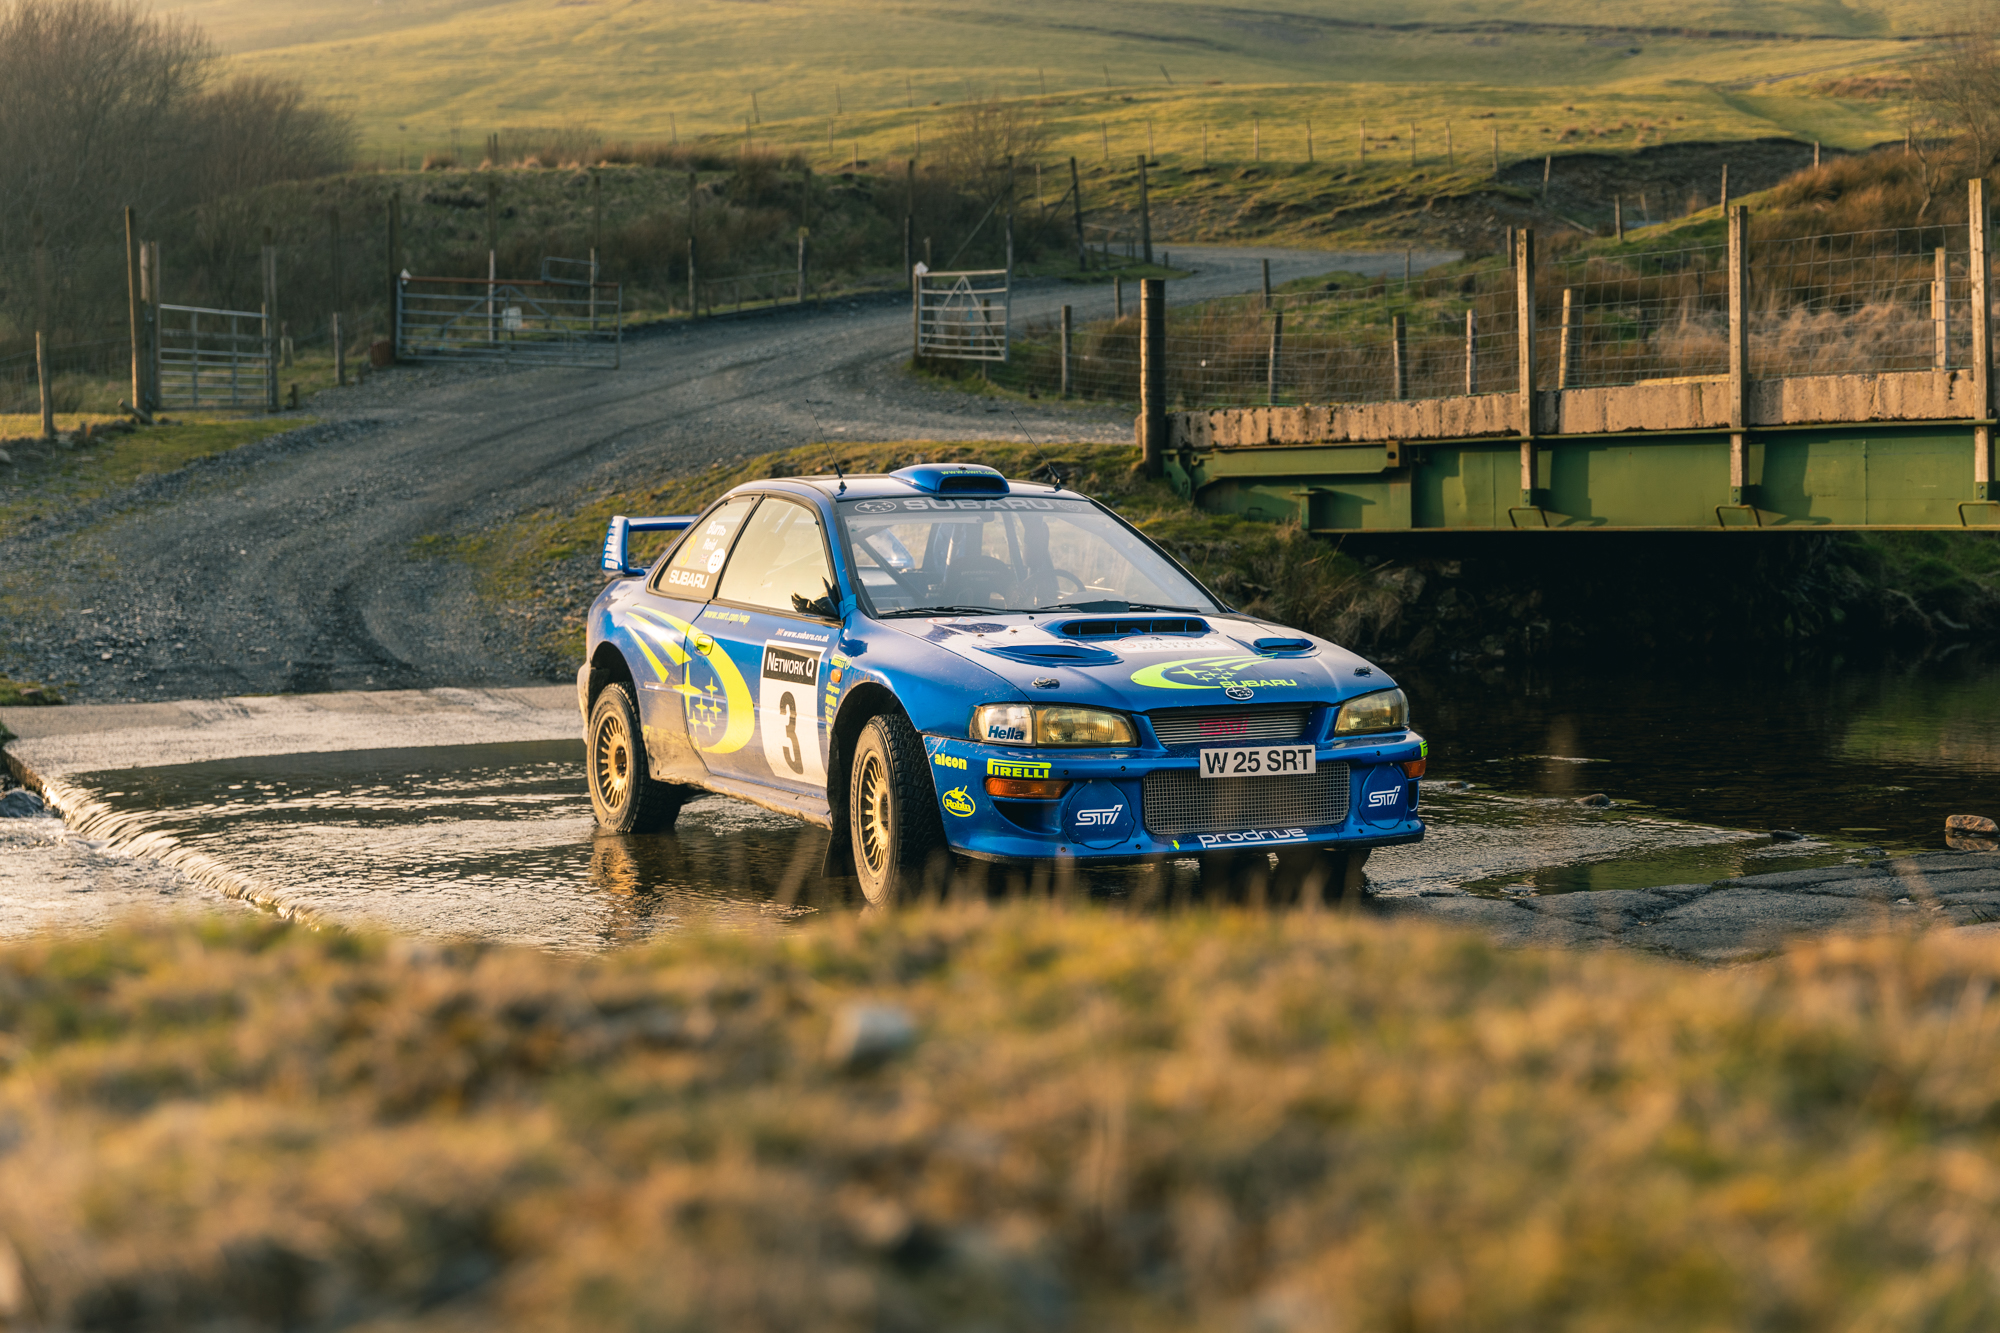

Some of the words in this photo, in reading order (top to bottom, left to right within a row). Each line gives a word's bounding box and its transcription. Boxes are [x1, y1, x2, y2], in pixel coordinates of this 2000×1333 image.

[903, 499, 1054, 511] SUBARU
[680, 534, 697, 566] 3
[668, 569, 710, 588] SUBARU
[782, 630, 830, 643] www.subaru.co.uk
[805, 657, 815, 678] Q
[1219, 679, 1297, 688] SUBARU
[780, 691, 804, 775] 3
[987, 725, 1025, 741] Hella
[934, 753, 967, 770] alcon
[987, 758, 1052, 779] PIRELLI
[1204, 751, 1229, 774] W
[1233, 750, 1261, 773] 25
[1266, 748, 1312, 773] SRT
[945, 798, 972, 812] Robin
[1197, 828, 1308, 848] prodrive
